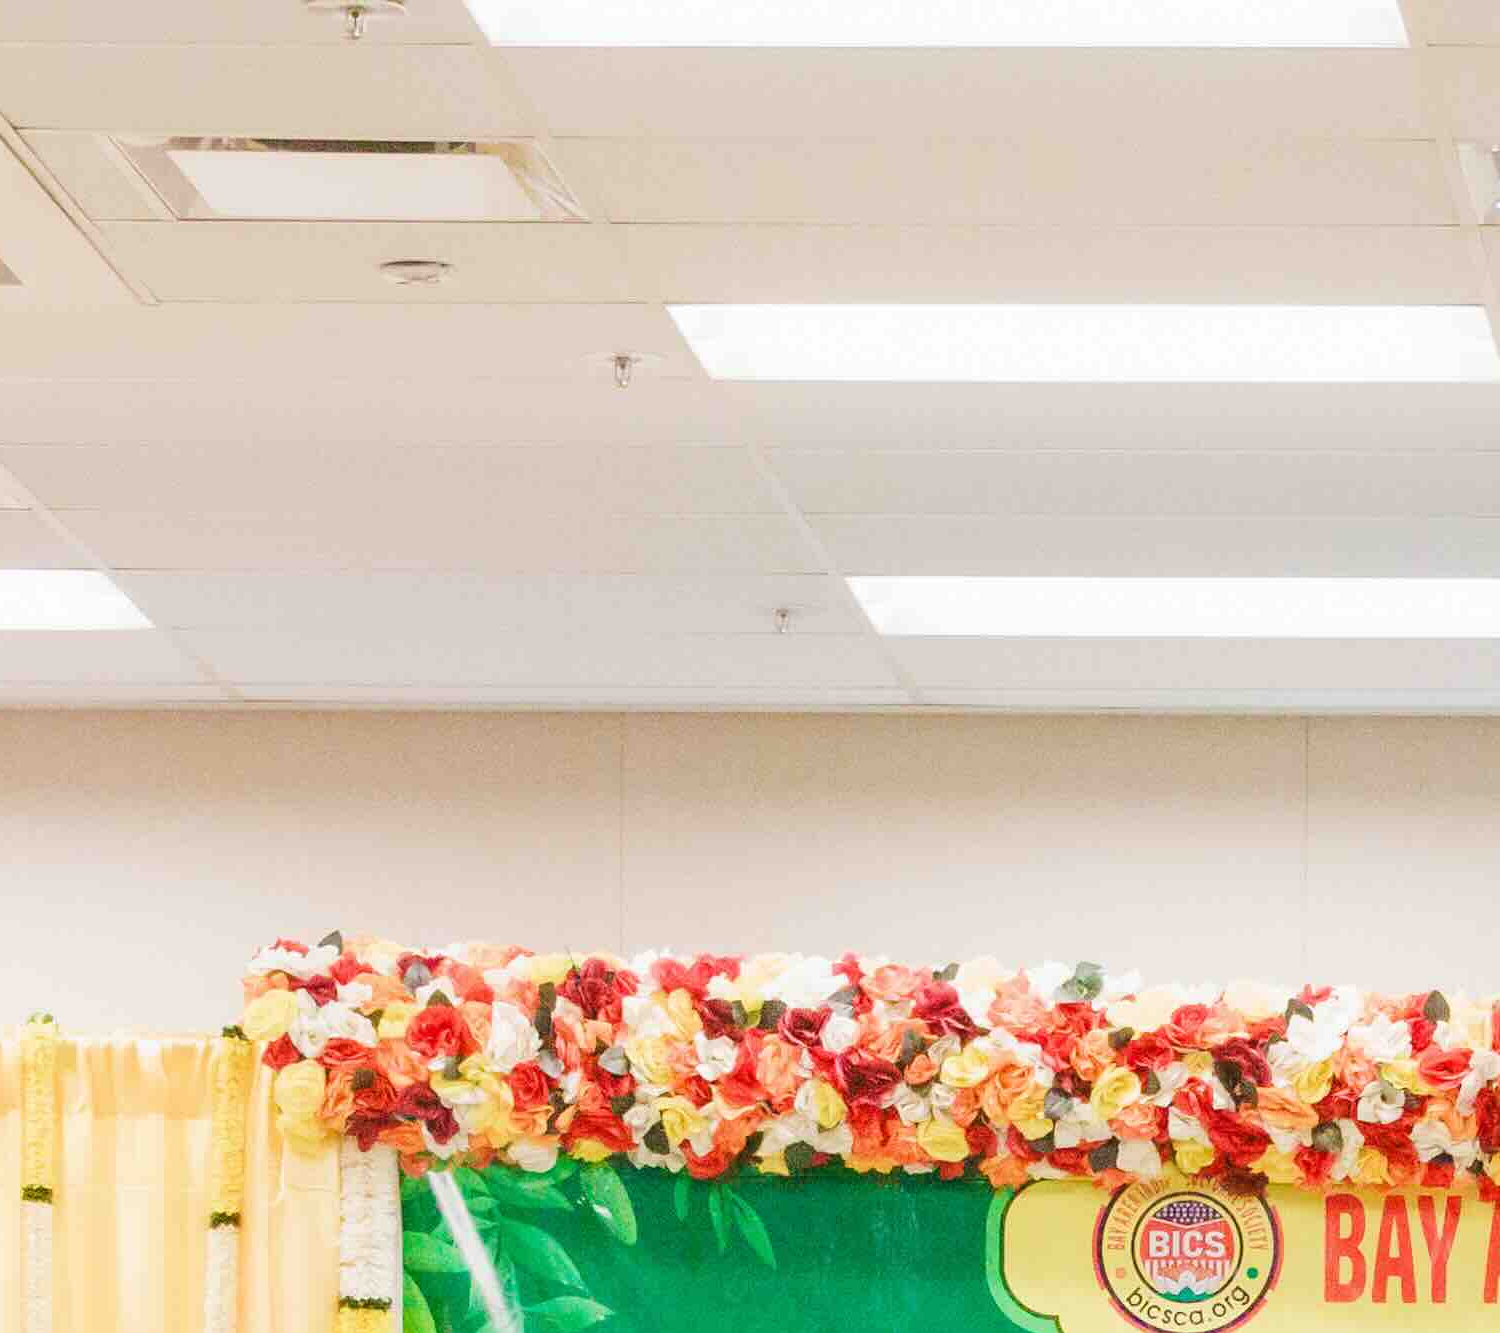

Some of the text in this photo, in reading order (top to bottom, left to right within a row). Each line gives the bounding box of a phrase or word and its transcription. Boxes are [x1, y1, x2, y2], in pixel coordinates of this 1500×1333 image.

[1149, 1230, 1226, 1258] BICS
[1323, 1193, 1463, 1304] BAY
[1127, 1285, 1250, 1327] bicsca.org
